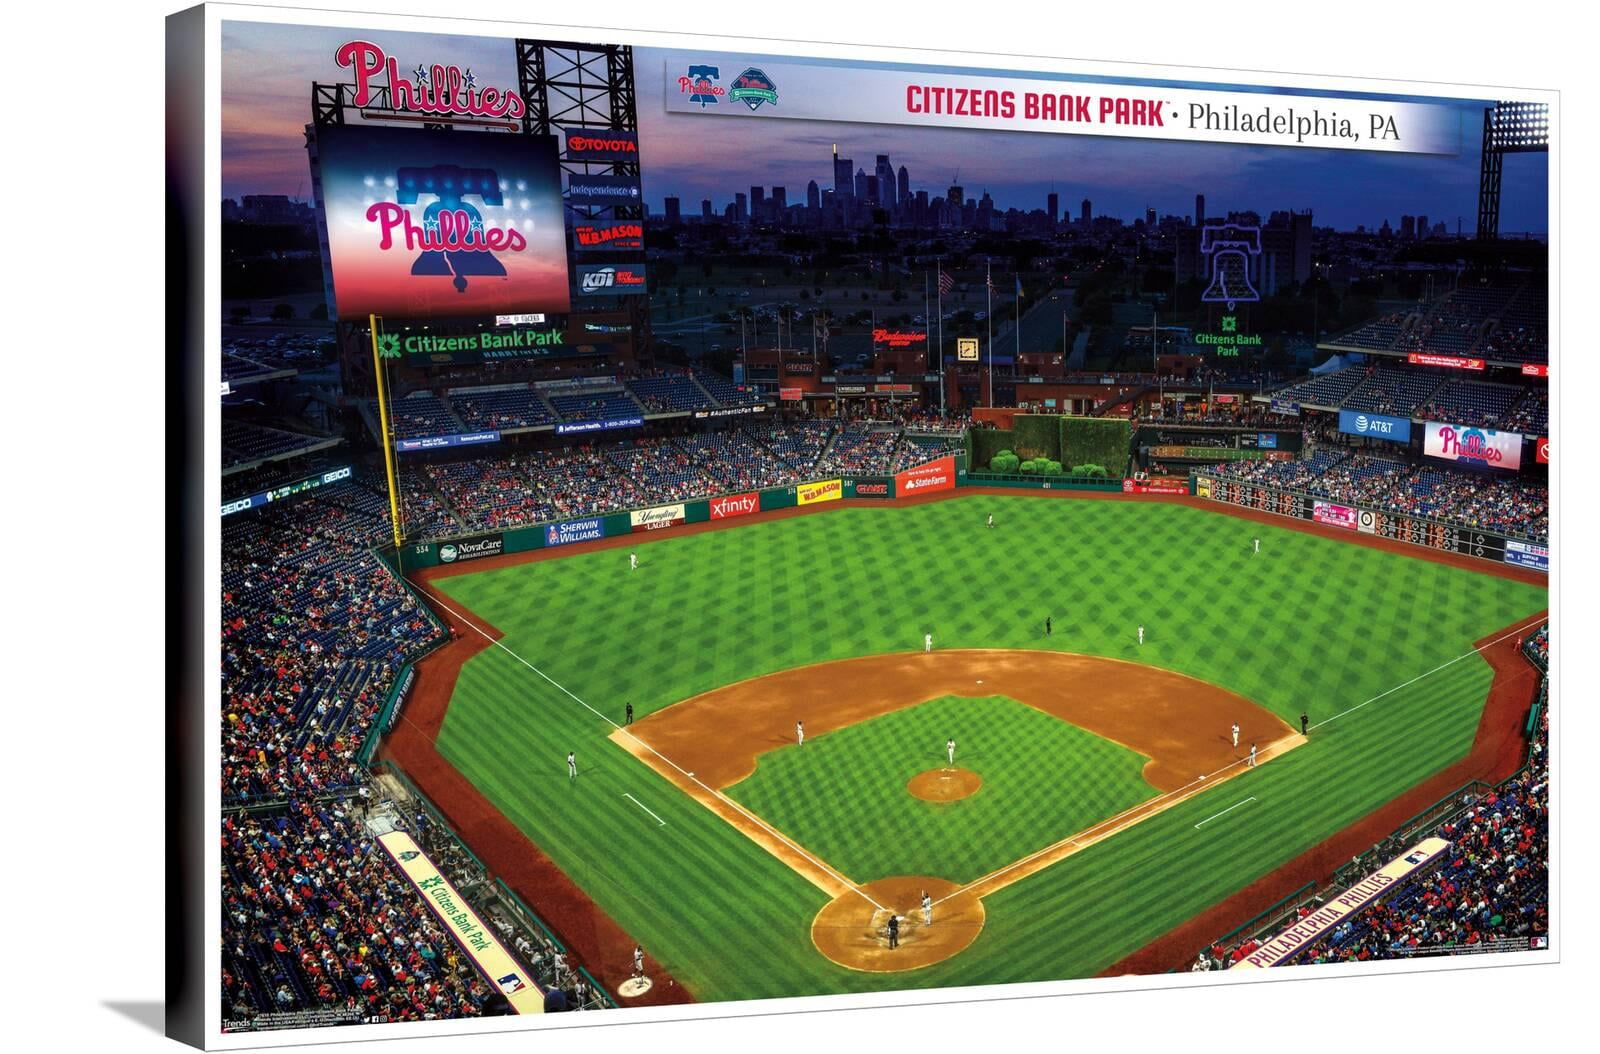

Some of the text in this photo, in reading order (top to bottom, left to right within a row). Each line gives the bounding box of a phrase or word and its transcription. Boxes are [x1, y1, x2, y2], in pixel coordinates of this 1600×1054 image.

[335, 40, 526, 118] Phillies
[678, 76, 725, 97] Phillies
[906, 84, 1401, 143] CITIZENS BANK PARK Philadelphia, PA
[586, 138, 636, 152] TOYOTA
[570, 185, 628, 196] Independence
[366, 201, 527, 252] Phillies
[582, 272, 615, 287] KDI
[405, 328, 563, 353] Citizens Bank Park
[872, 329, 927, 342] Budweiser
[1195, 333, 1262, 345] Citizens Bank
[483, 349, 518, 358] HARRY
[1217, 345, 1239, 356] Park
[1369, 420, 1394, 434] AT&T
[1439, 426, 1503, 462] Phillies
[323, 467, 351, 483] GEICO
[855, 484, 888, 494] GIANT
[220, 498, 252, 516] GEICO
[713, 495, 757, 517] xfinity
[638, 507, 678, 523] Yuengling
[560, 520, 599, 533] SHERWIN
[646, 520, 671, 530] LAGER
[457, 540, 502, 554] NovaCare
[458, 549, 501, 560] REHABILITATION
[430, 886, 492, 952] Citizens Bank Park
[1250, 872, 1394, 968] PHILADELPHIA PHILLIES
[223, 1018, 251, 1028] Trends
